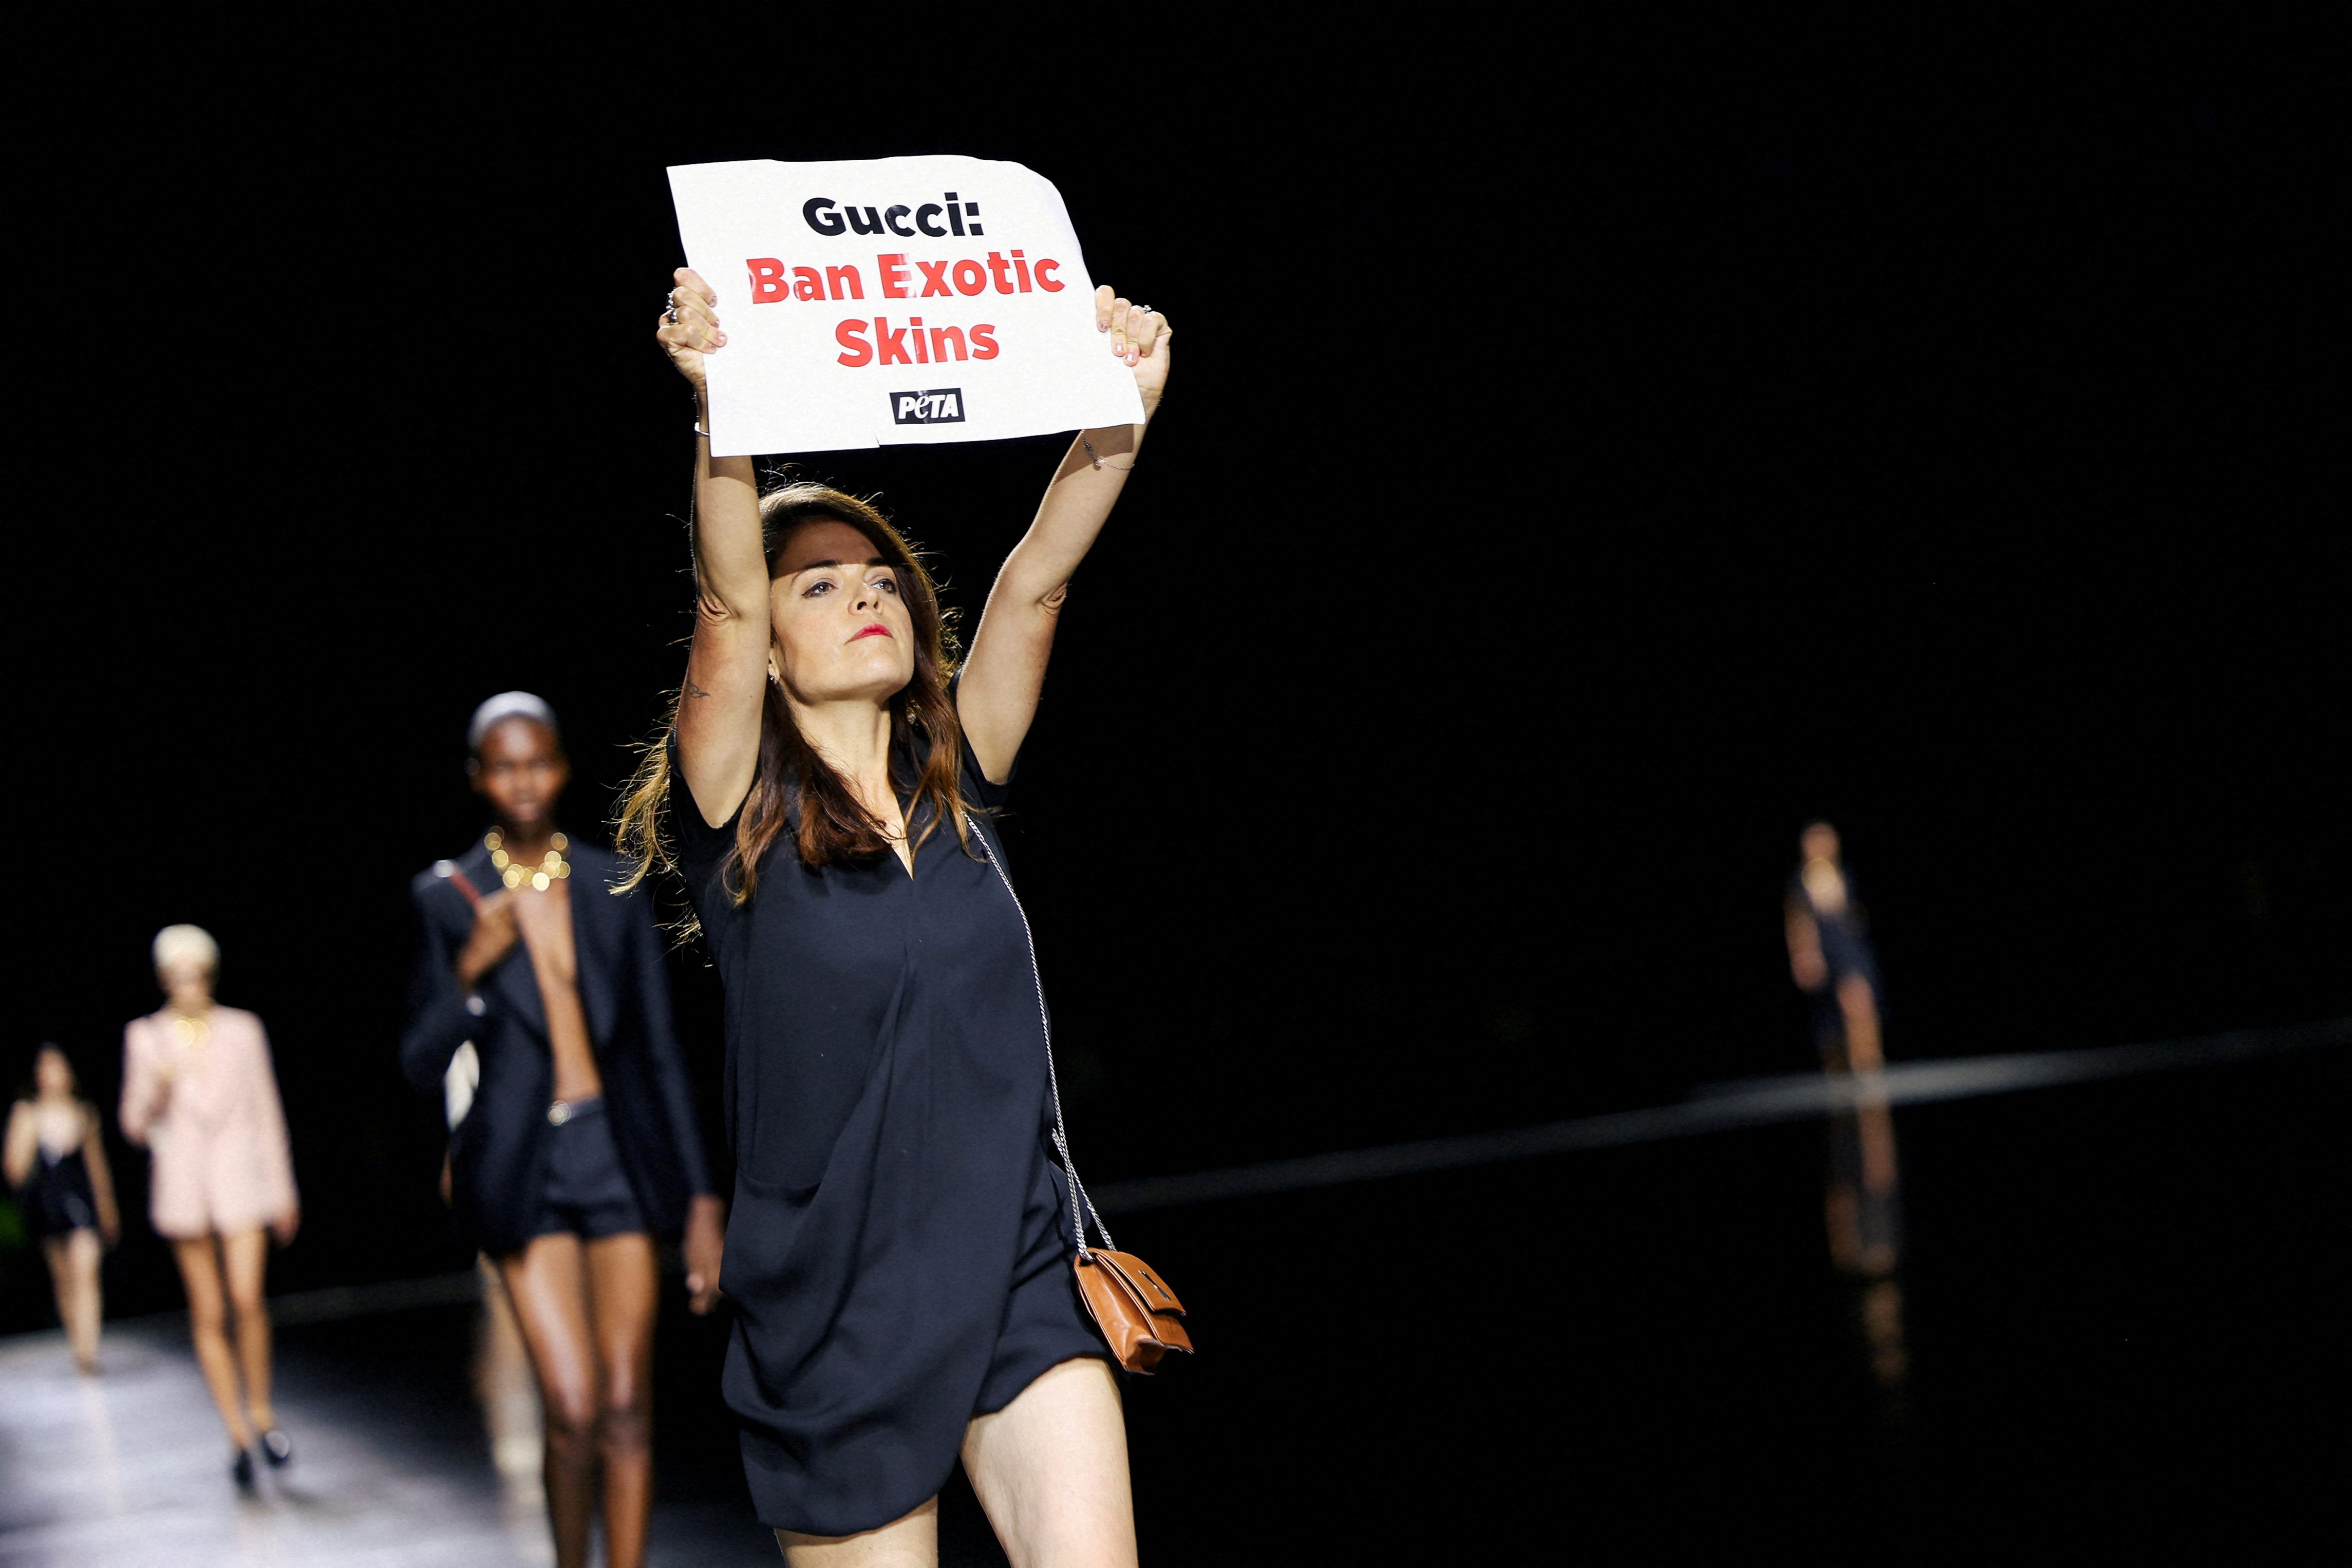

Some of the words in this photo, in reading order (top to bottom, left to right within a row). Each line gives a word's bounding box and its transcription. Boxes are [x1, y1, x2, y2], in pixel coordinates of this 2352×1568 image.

[802, 192, 984, 237] Gucci:
[746, 257, 864, 305] Ban
[877, 249, 1065, 299] Exotic
[835, 316, 1000, 368] Skins
